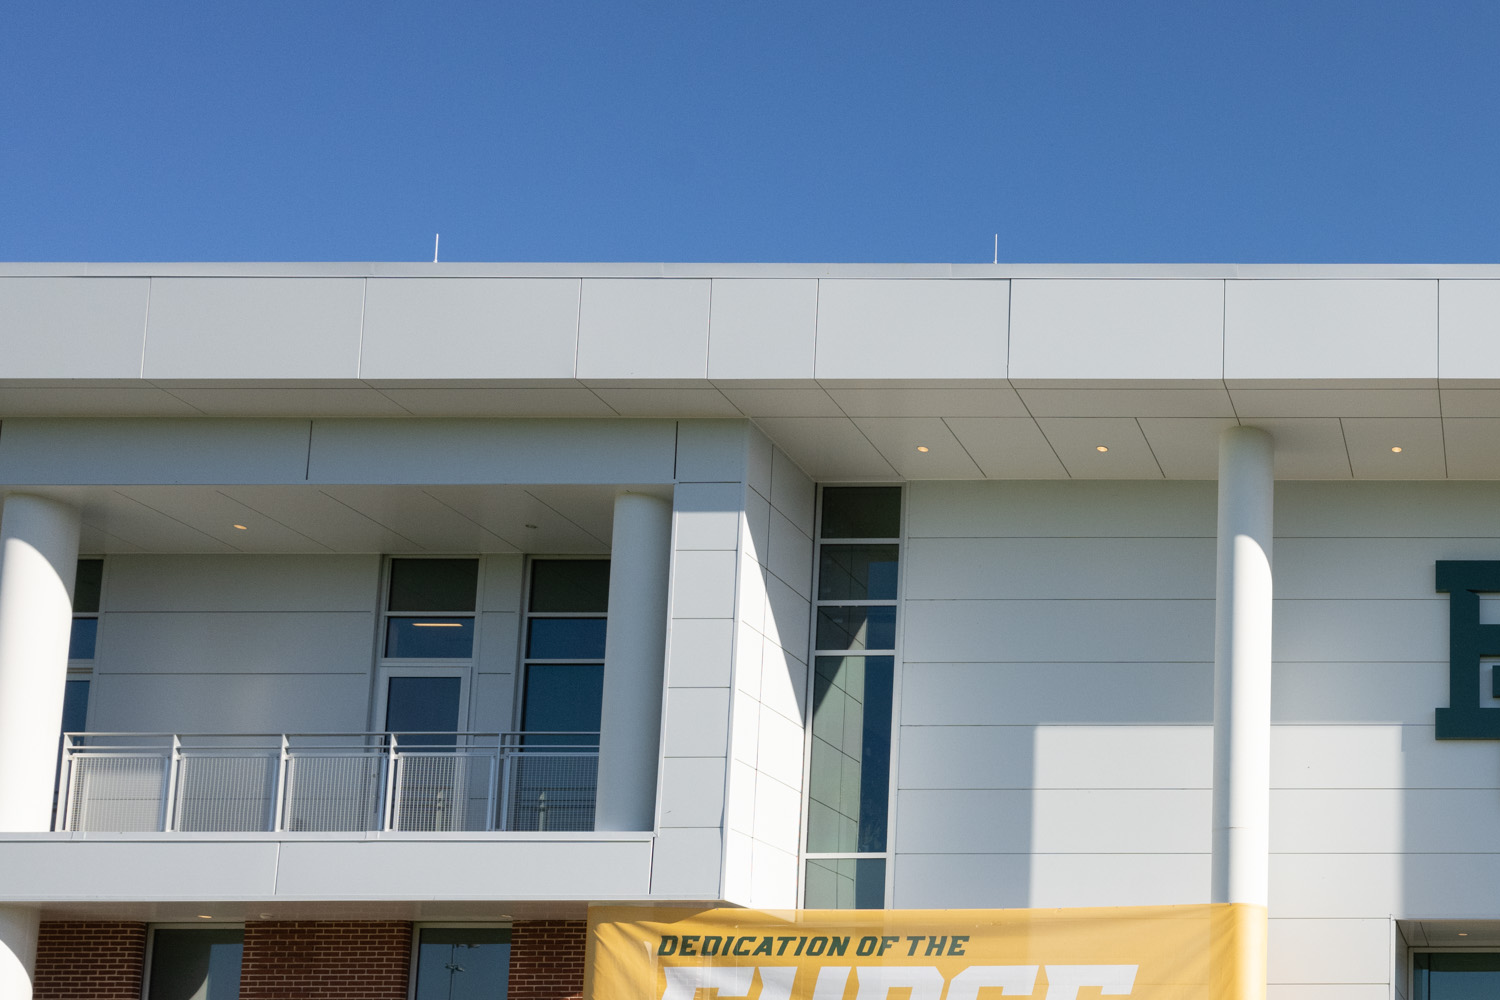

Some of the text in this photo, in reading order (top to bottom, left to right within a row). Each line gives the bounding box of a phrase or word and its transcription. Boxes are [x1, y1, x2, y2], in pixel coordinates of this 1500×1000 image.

[657, 935, 970, 956] DEDICATION OF THE
